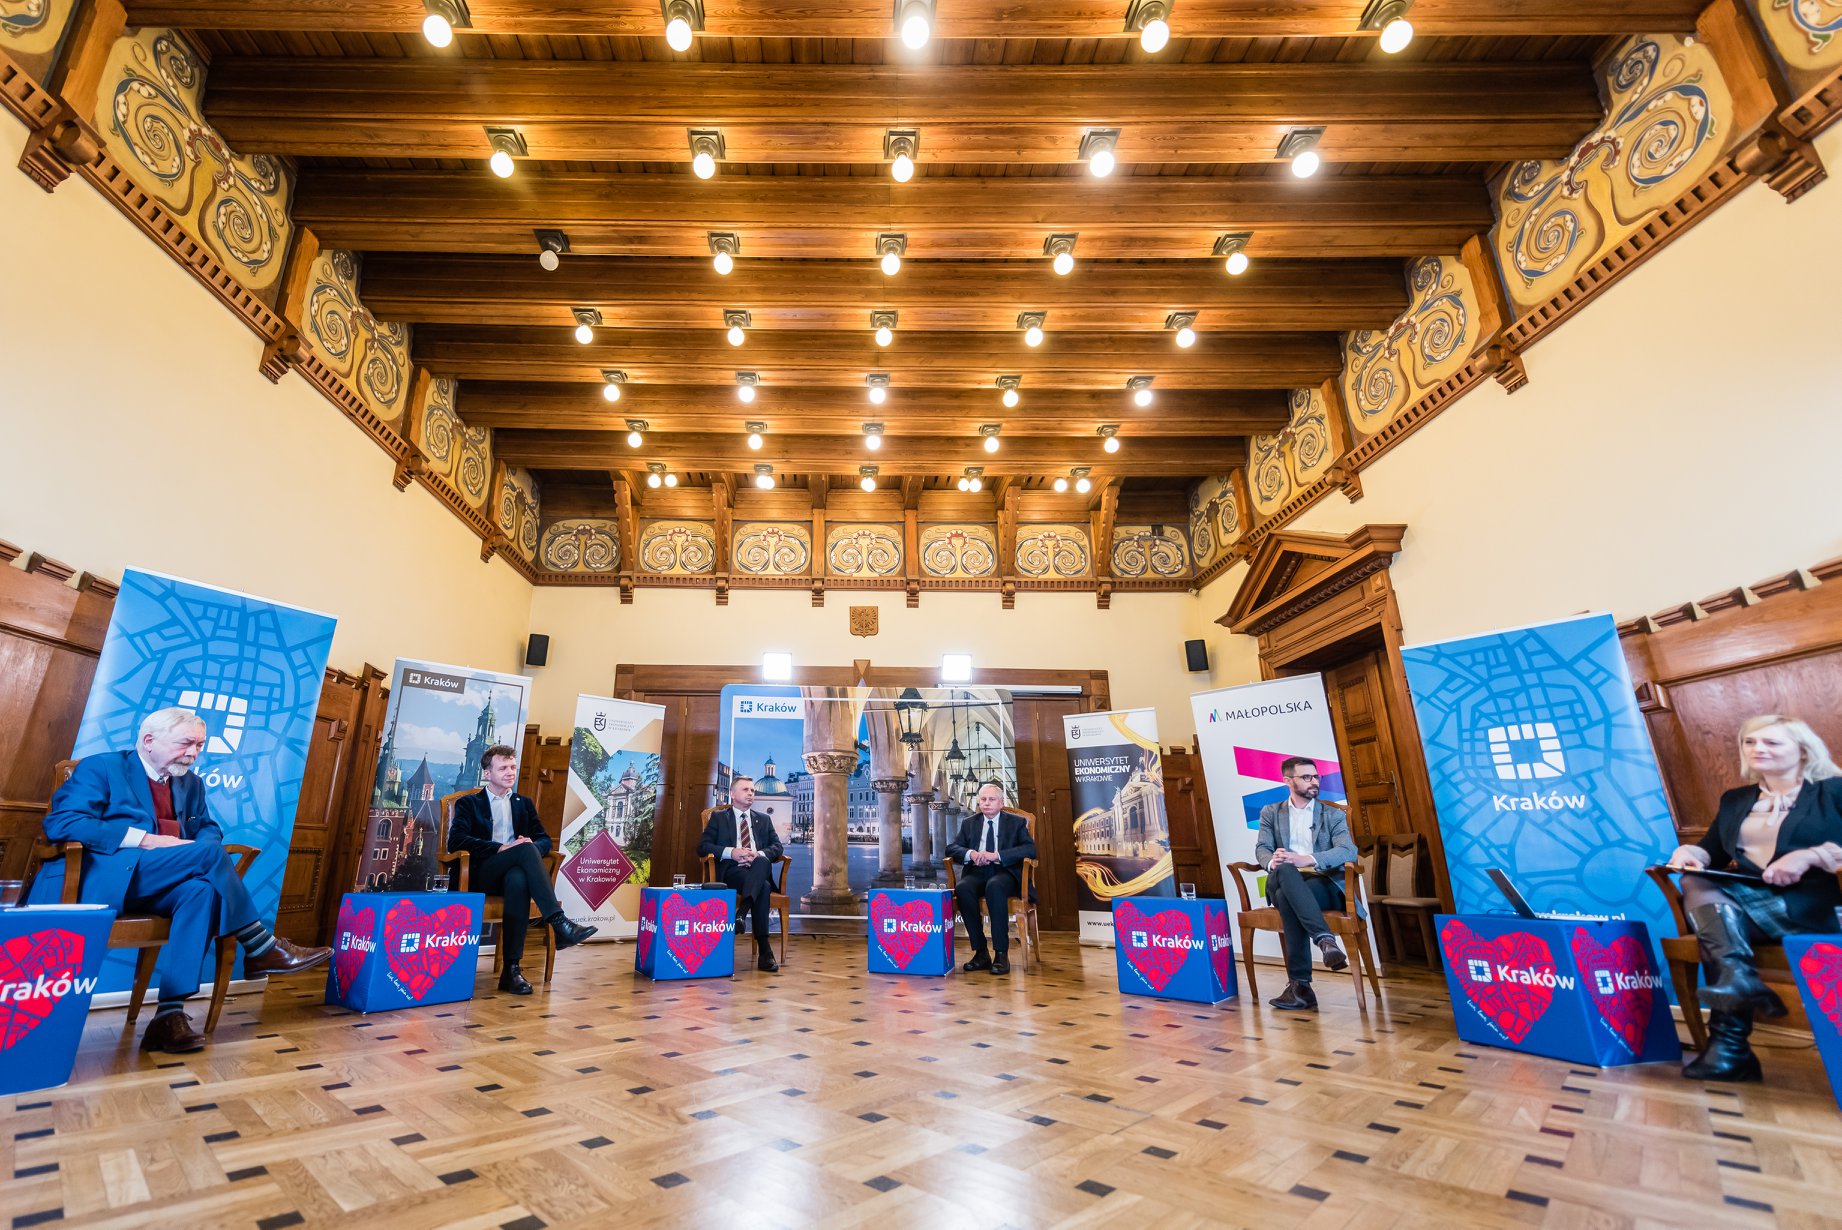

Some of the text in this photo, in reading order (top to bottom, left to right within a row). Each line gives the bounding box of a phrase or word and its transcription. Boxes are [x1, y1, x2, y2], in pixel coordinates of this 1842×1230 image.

[424, 676, 459, 688] Kraków
[756, 702, 797, 713] Kraków
[1225, 700, 1313, 721] MAŁOPOLSKA
[1074, 756, 1129, 767] UNIWERSYTET
[1074, 765, 1131, 775] EKONOMICZNY
[1492, 790, 1586, 812] Kraków
[580, 857, 620, 866] Uniwersytet
[576, 867, 621, 875] Ekonomiczny
[693, 920, 735, 933] Kraków
[900, 920, 942, 934] Kraków
[350, 934, 377, 953] Kraków
[425, 931, 480, 949] Kraków
[1152, 934, 1204, 950] Kraków
[1496, 965, 1575, 991] Kraków
[1614, 969, 1663, 991] Kraków
[0, 971, 98, 1002] raków
